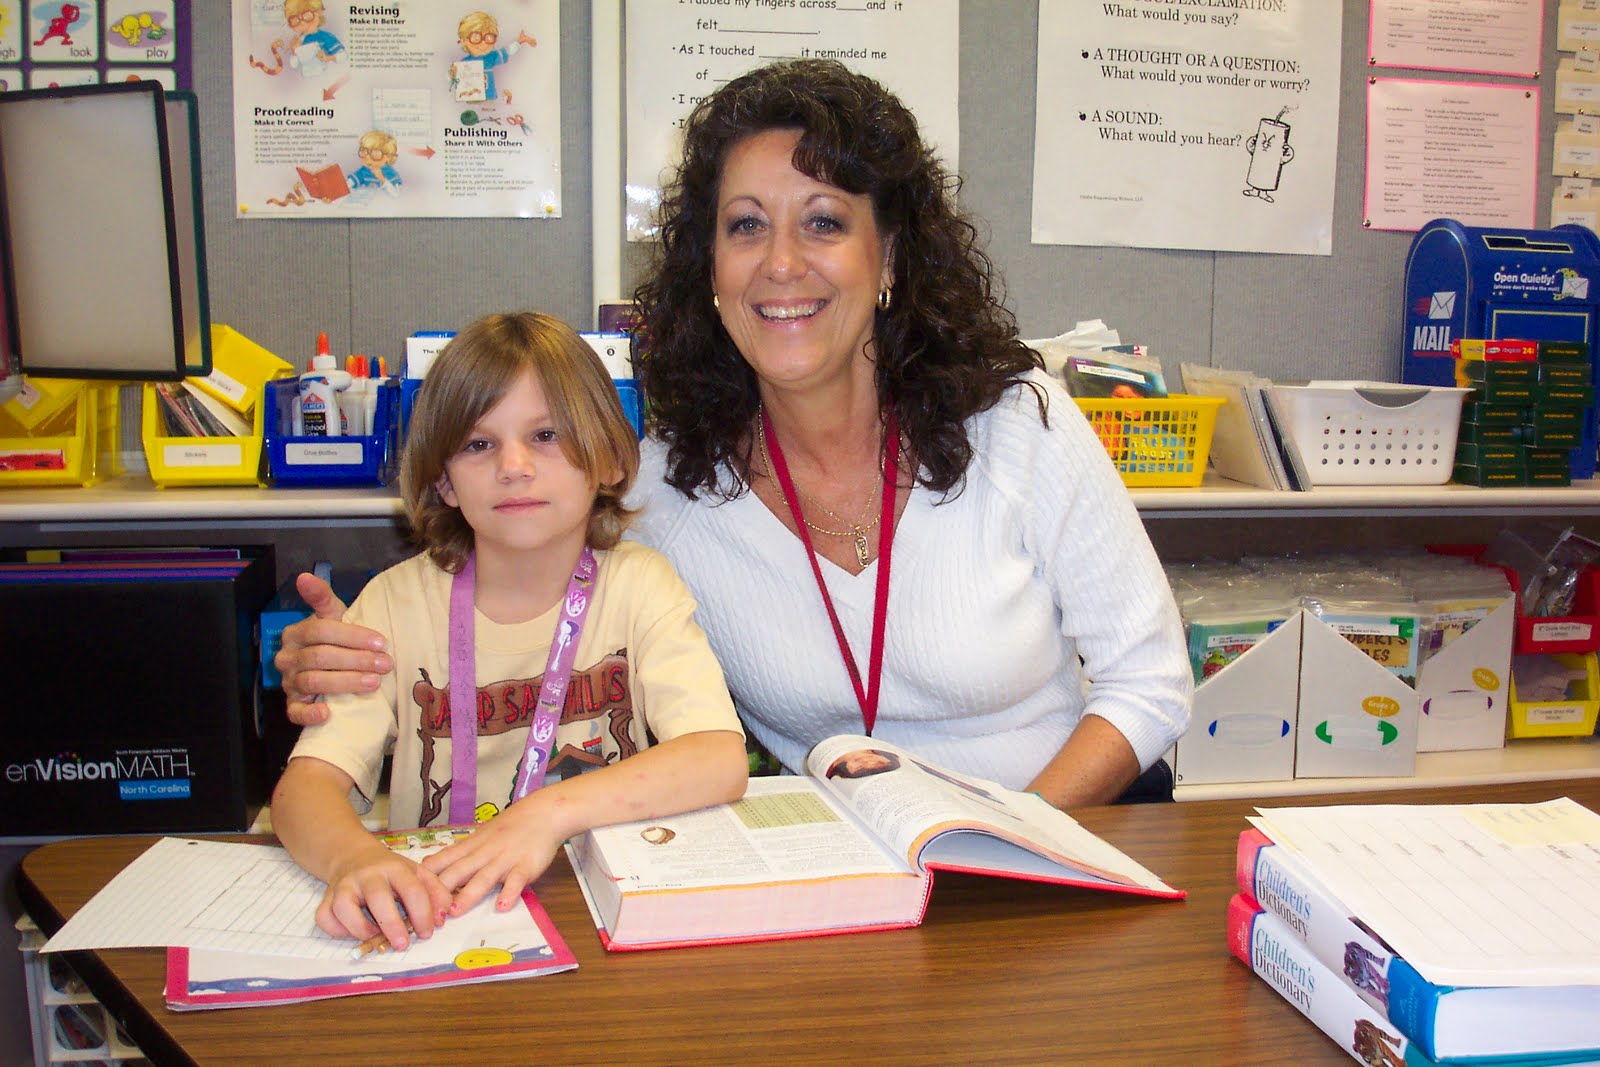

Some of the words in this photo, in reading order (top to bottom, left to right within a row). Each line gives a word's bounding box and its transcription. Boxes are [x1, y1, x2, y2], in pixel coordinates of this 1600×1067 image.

[350, 6, 400, 18] Revising
[800, 1, 837, 9] across
[866, 1, 886, 10] and
[894, 1, 903, 11] it
[1102, 3, 1138, 18] What
[1142, 8, 1180, 21] would
[1184, 13, 1206, 25] you
[1210, 12, 1239, 27] say?
[696, 19, 718, 30] felt
[70, 48, 92, 58] look
[146, 48, 169, 59] play
[679, 45, 694, 55] As
[699, 45, 705, 55] I
[710, 45, 755, 56] touched
[801, 48, 809, 58] it
[814, 48, 867, 59] reminded
[871, 50, 888, 59] me
[1093, 48, 1104, 60] A
[1106, 48, 1182, 66] THOUGHT
[1185, 53, 1206, 67] OR
[1209, 55, 1221, 68] A
[1223, 56, 1301, 73] QUESTION:
[696, 70, 709, 81] of
[1101, 65, 1135, 80] What
[1139, 68, 1176, 82] would
[1180, 72, 1202, 85] you
[1206, 72, 1251, 87] wonder
[1254, 78, 1266, 88] or
[1269, 79, 1310, 93] worry?
[679, 94, 685, 104] I
[254, 107, 334, 119] Proofreading
[1092, 110, 1103, 123] A
[1105, 110, 1162, 126] SOUND:
[444, 128, 508, 140] Publishing
[1098, 127, 1133, 142] What
[1138, 130, 1176, 144] would
[1180, 134, 1203, 147] you
[1207, 134, 1242, 147] hear?
[1493, 272, 1519, 284] Open
[1520, 273, 1556, 286] Quietly!
[1413, 326, 1452, 350] MAIL
[120, 784, 148, 795] North
[149, 783, 190, 794] Carolina
[1258, 859, 1312, 921] Children's
[1257, 879, 1309, 944] Dictionary
[1256, 928, 1315, 993] Children's
[1253, 946, 1313, 1014] Dictionary
